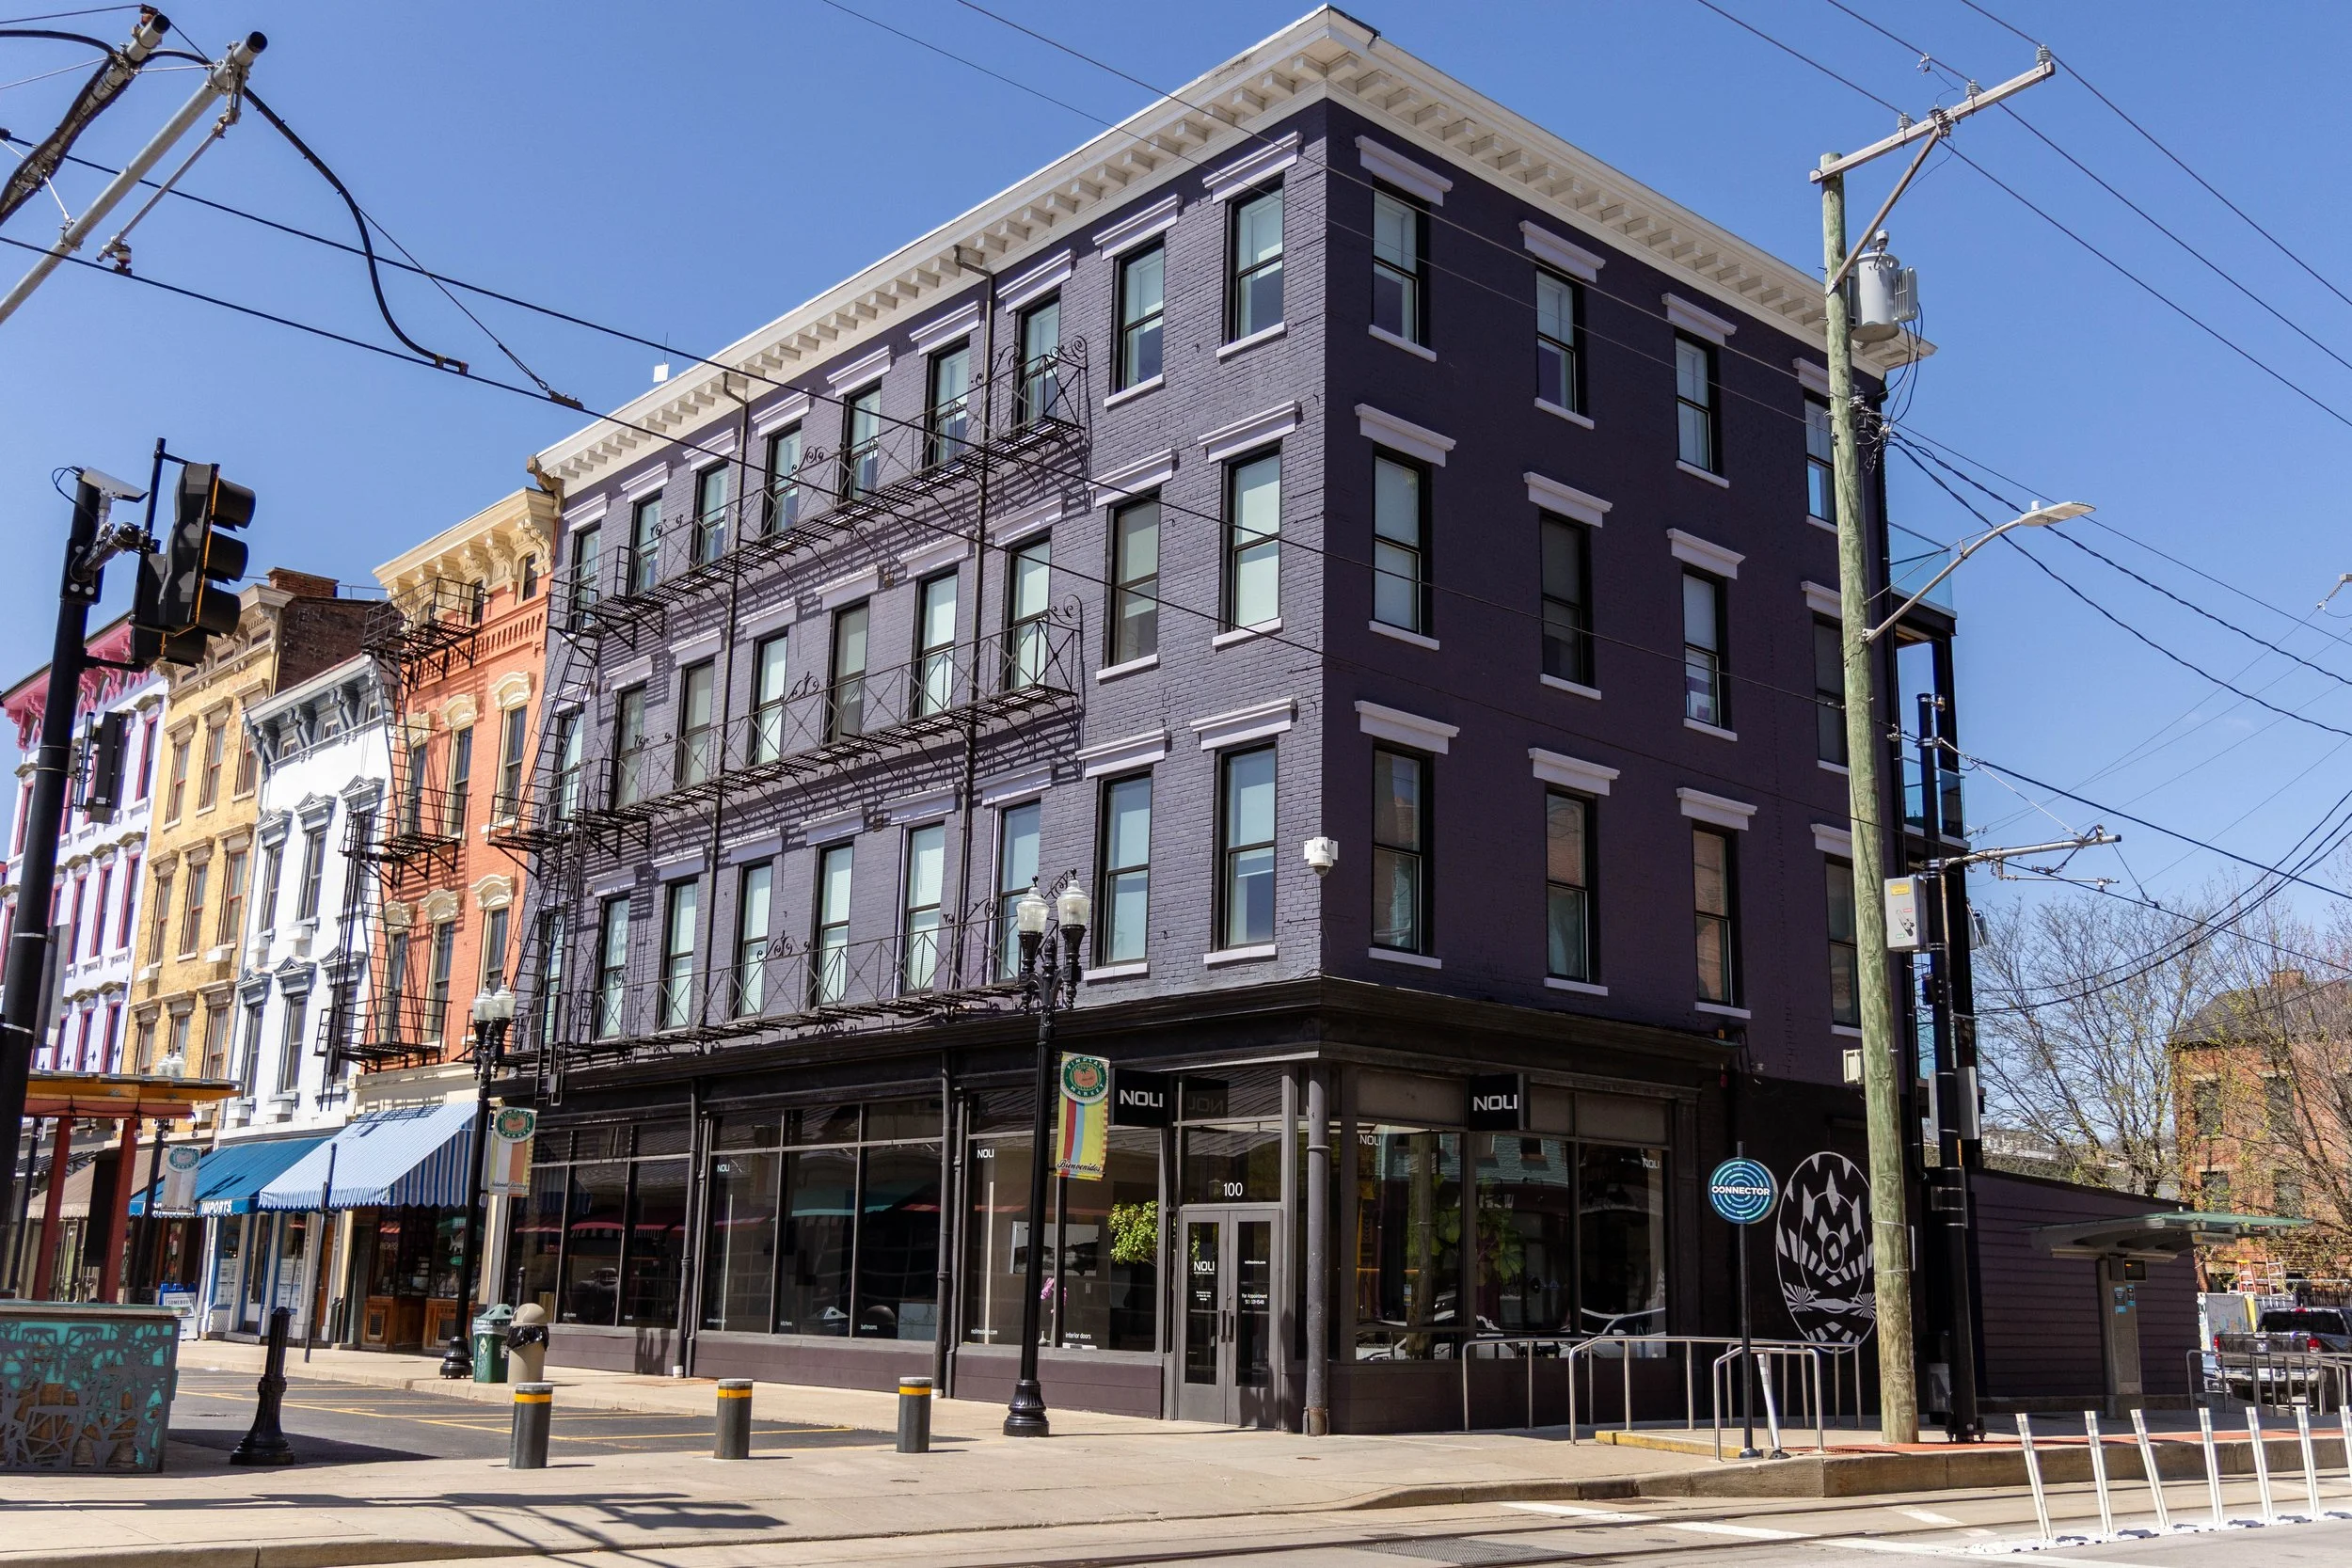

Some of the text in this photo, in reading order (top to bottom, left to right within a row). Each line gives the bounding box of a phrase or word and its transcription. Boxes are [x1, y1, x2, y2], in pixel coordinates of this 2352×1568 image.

[1067, 1058, 1103, 1069] FINDLAY
[1070, 1083, 1104, 1097] MARKET
[1120, 1089, 1163, 1108] NOLI
[1473, 1094, 1518, 1112] NOLI
[1359, 1134, 1381, 1147] NOLI
[977, 1148, 994, 1158] NOLI
[717, 1164, 730, 1172] NOLI
[1057, 1159, 1101, 1172] Bienvenidos
[1223, 1182, 1243, 1196] 100
[1711, 1185, 1771, 1196] CONNECTOR
[200, 1200, 232, 1213] IMPORTS
[1193, 1260, 1216, 1272] NOLI
